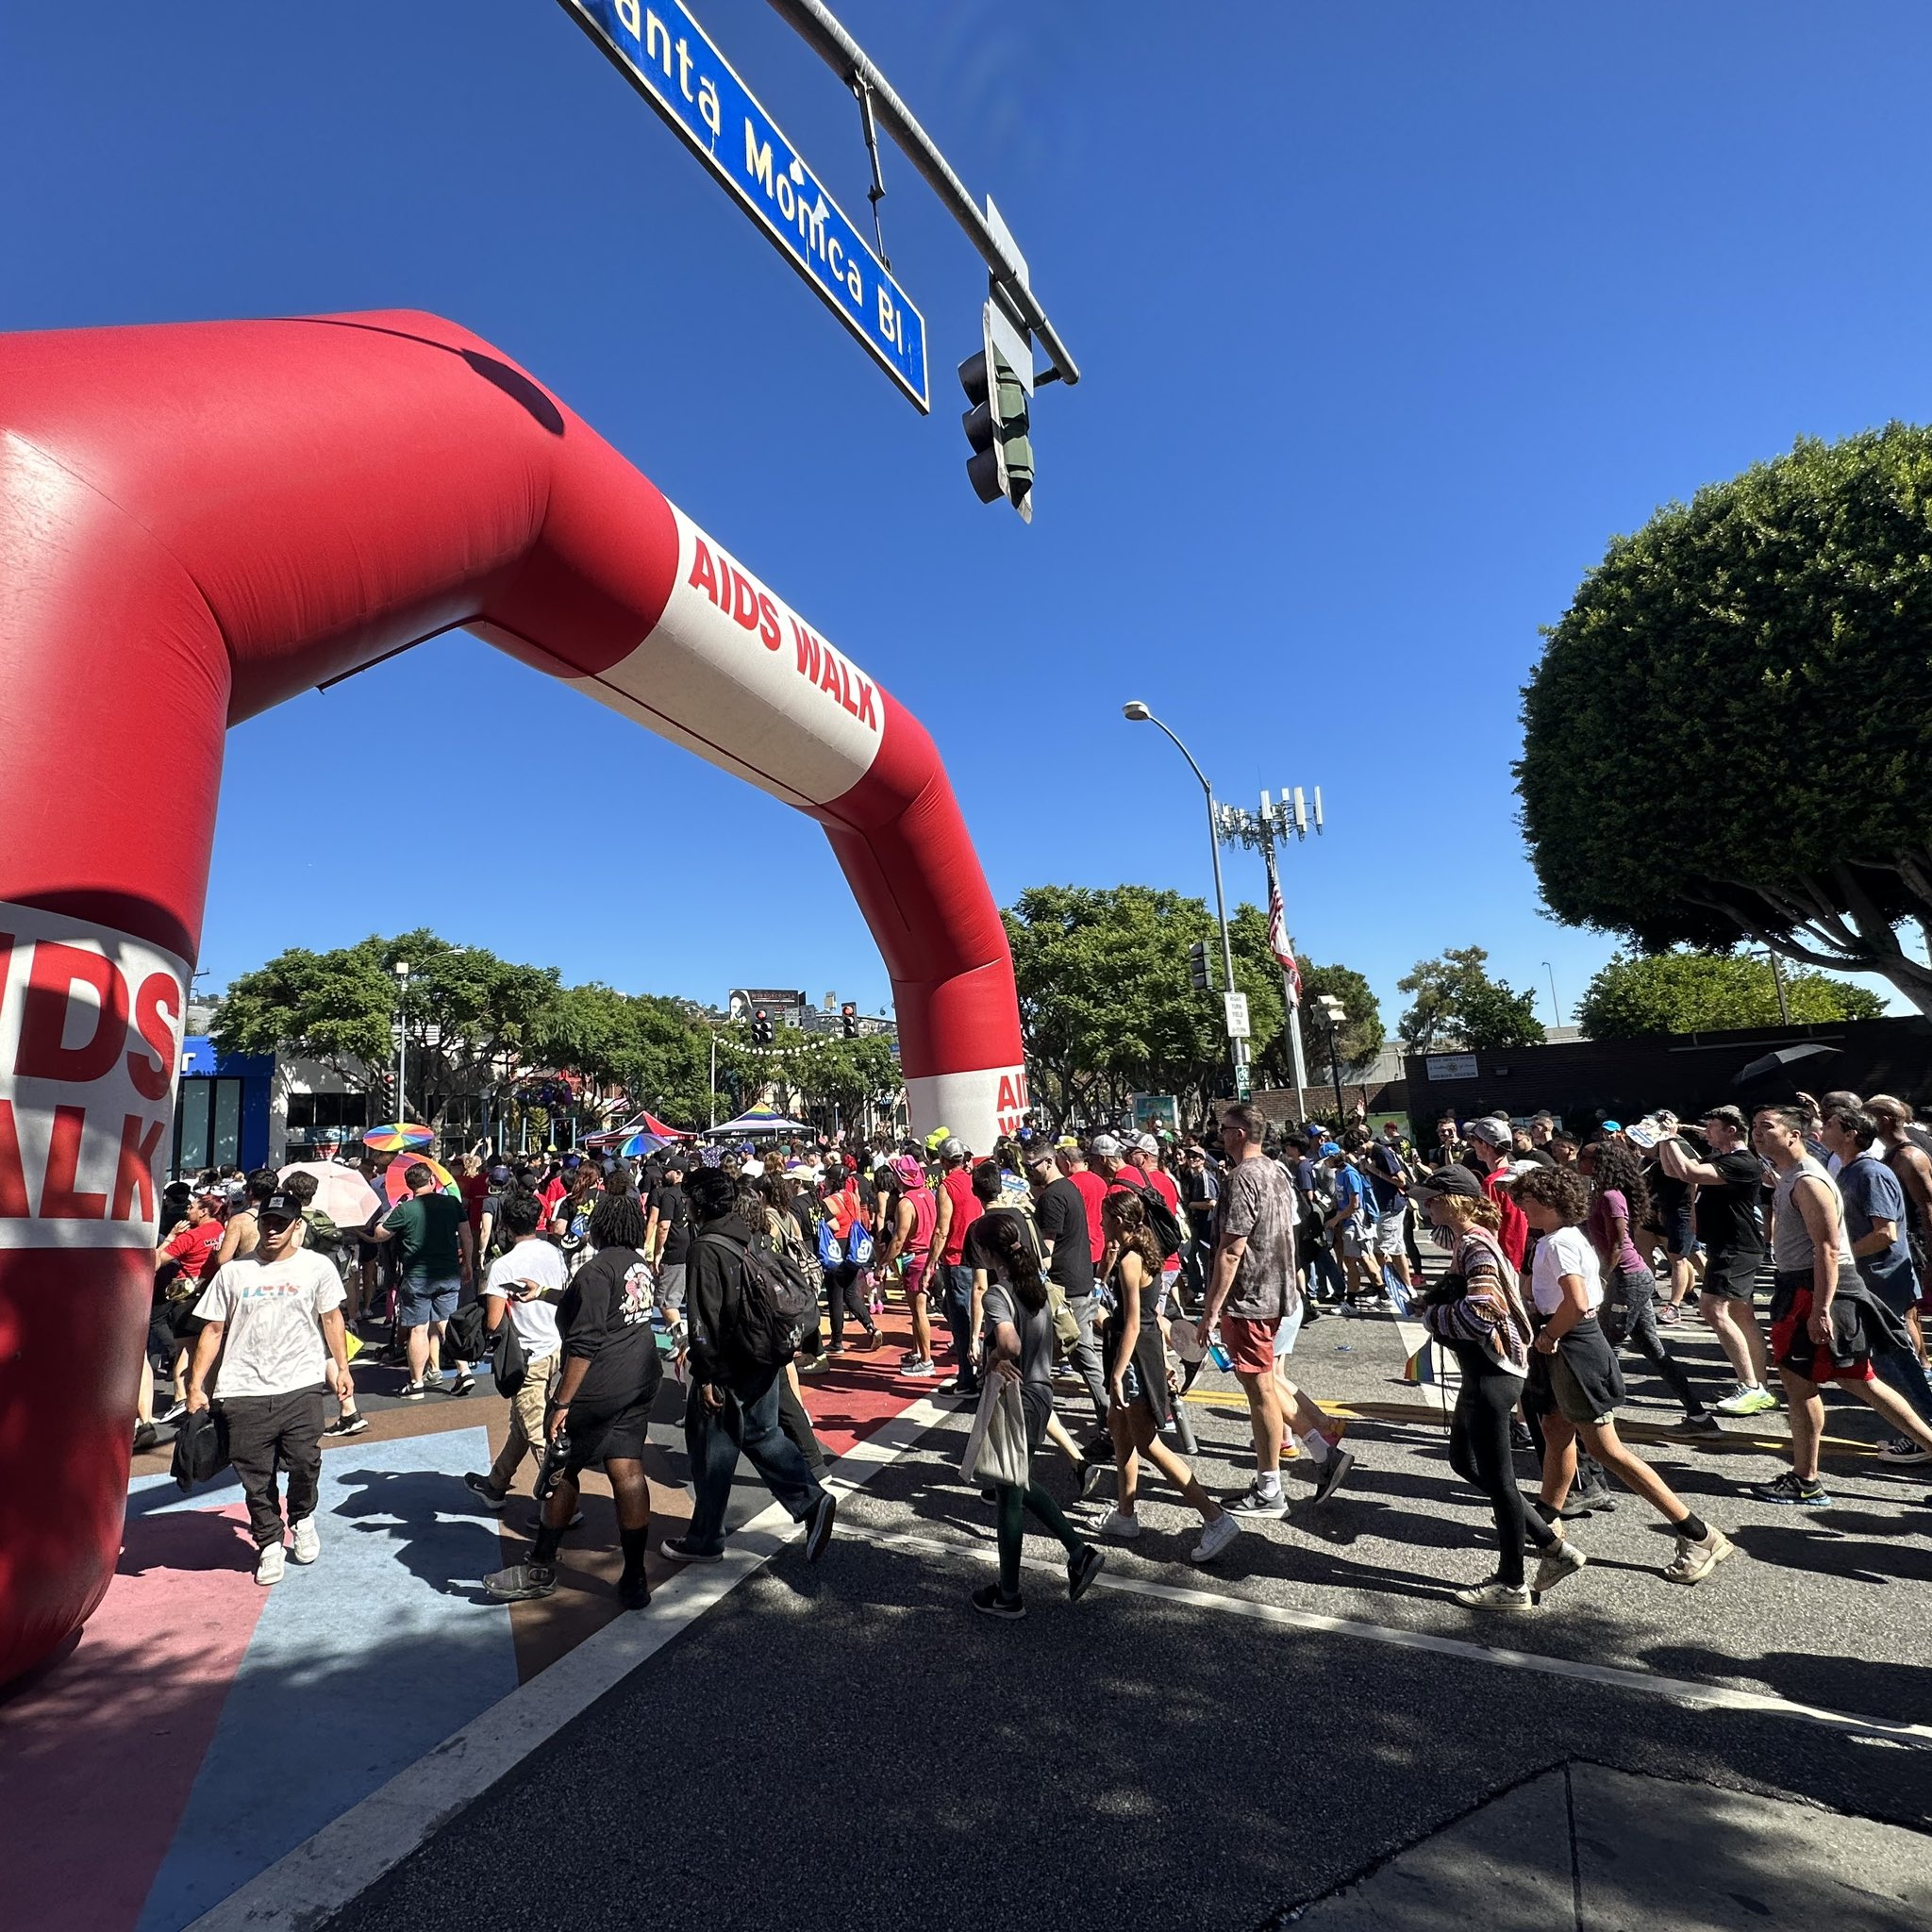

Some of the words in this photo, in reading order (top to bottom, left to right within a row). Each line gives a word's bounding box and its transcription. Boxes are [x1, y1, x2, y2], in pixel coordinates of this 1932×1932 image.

[745, 117, 862, 308] Monica
[878, 284, 903, 357] Bl
[688, 535, 782, 652] AIDS
[788, 615, 877, 733] WALK
